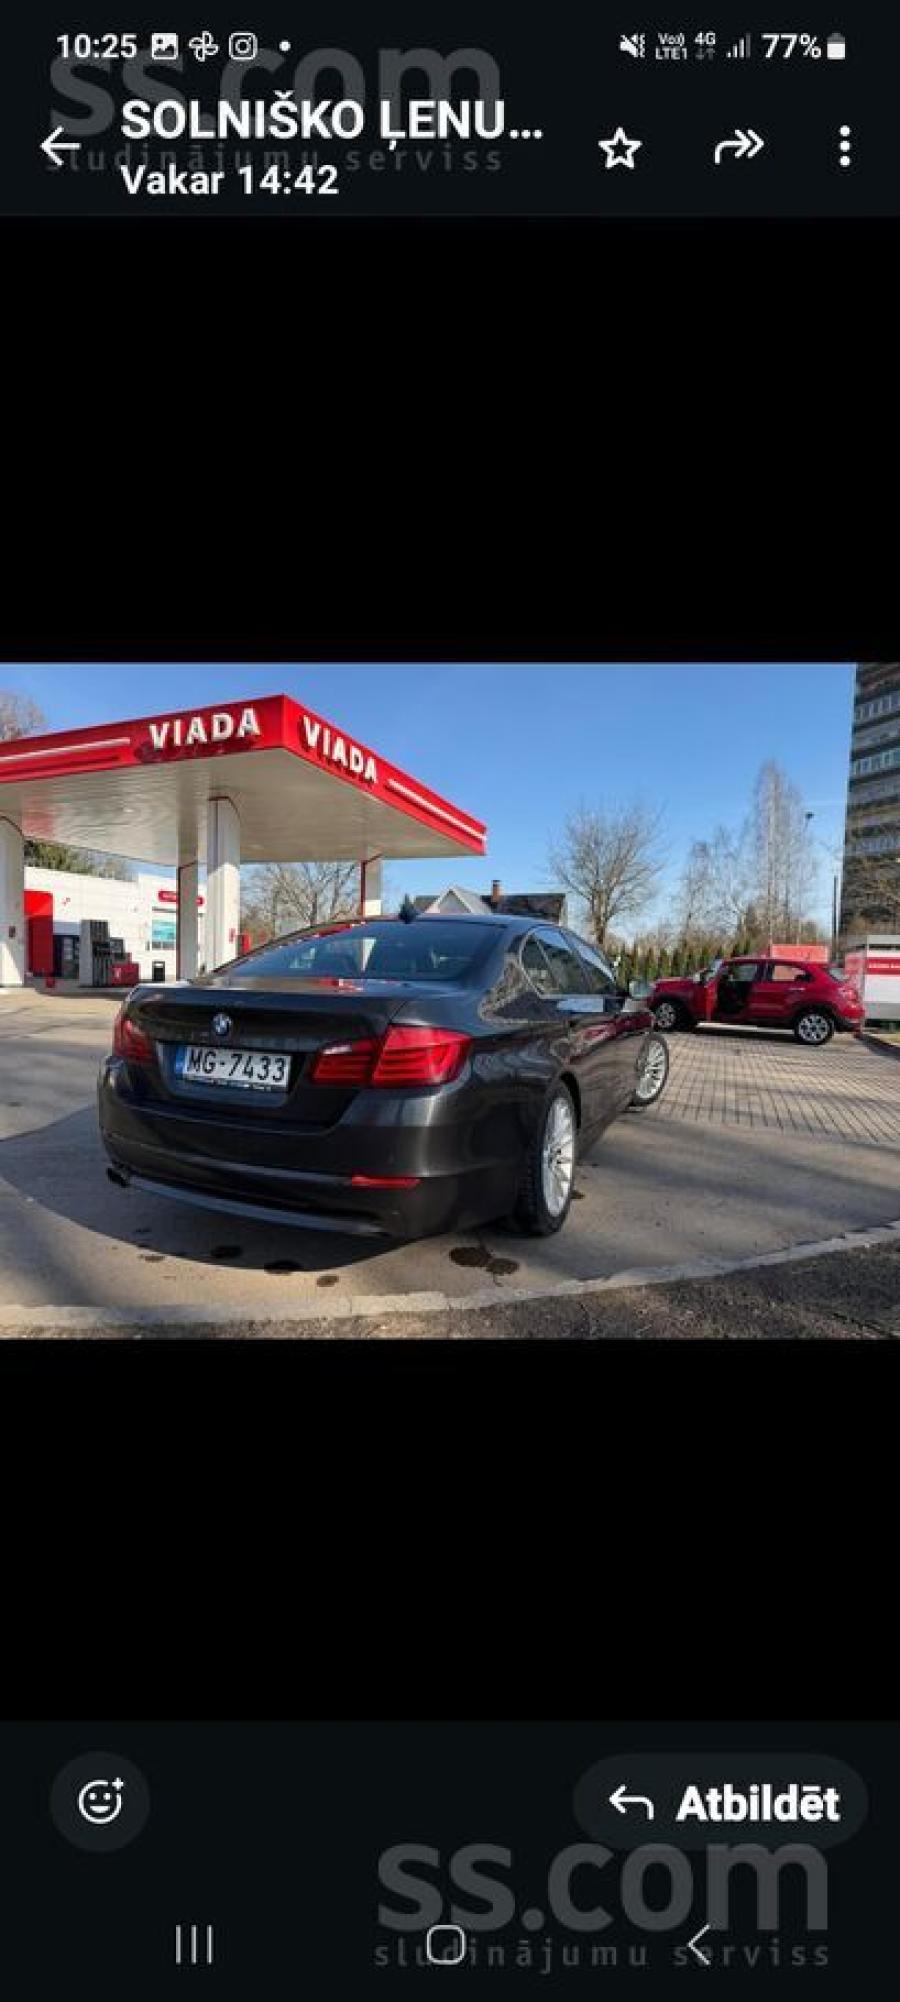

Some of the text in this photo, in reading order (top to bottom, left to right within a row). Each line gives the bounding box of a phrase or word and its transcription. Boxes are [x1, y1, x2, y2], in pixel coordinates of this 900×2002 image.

[57, 34, 137, 58] 10:25
[656, 47, 687, 60] LTE1
[694, 33, 716, 45] 4G
[761, 33, 822, 58] 77%
[121, 91, 364, 139] SOLNIŠKO
[121, 163, 339, 195] Vakar 14:42
[149, 707, 261, 749] VIADA
[303, 714, 378, 783] VIADA
[187, 1048, 286, 1082] MG-7433
[676, 1784, 840, 1822] Atbildēt
